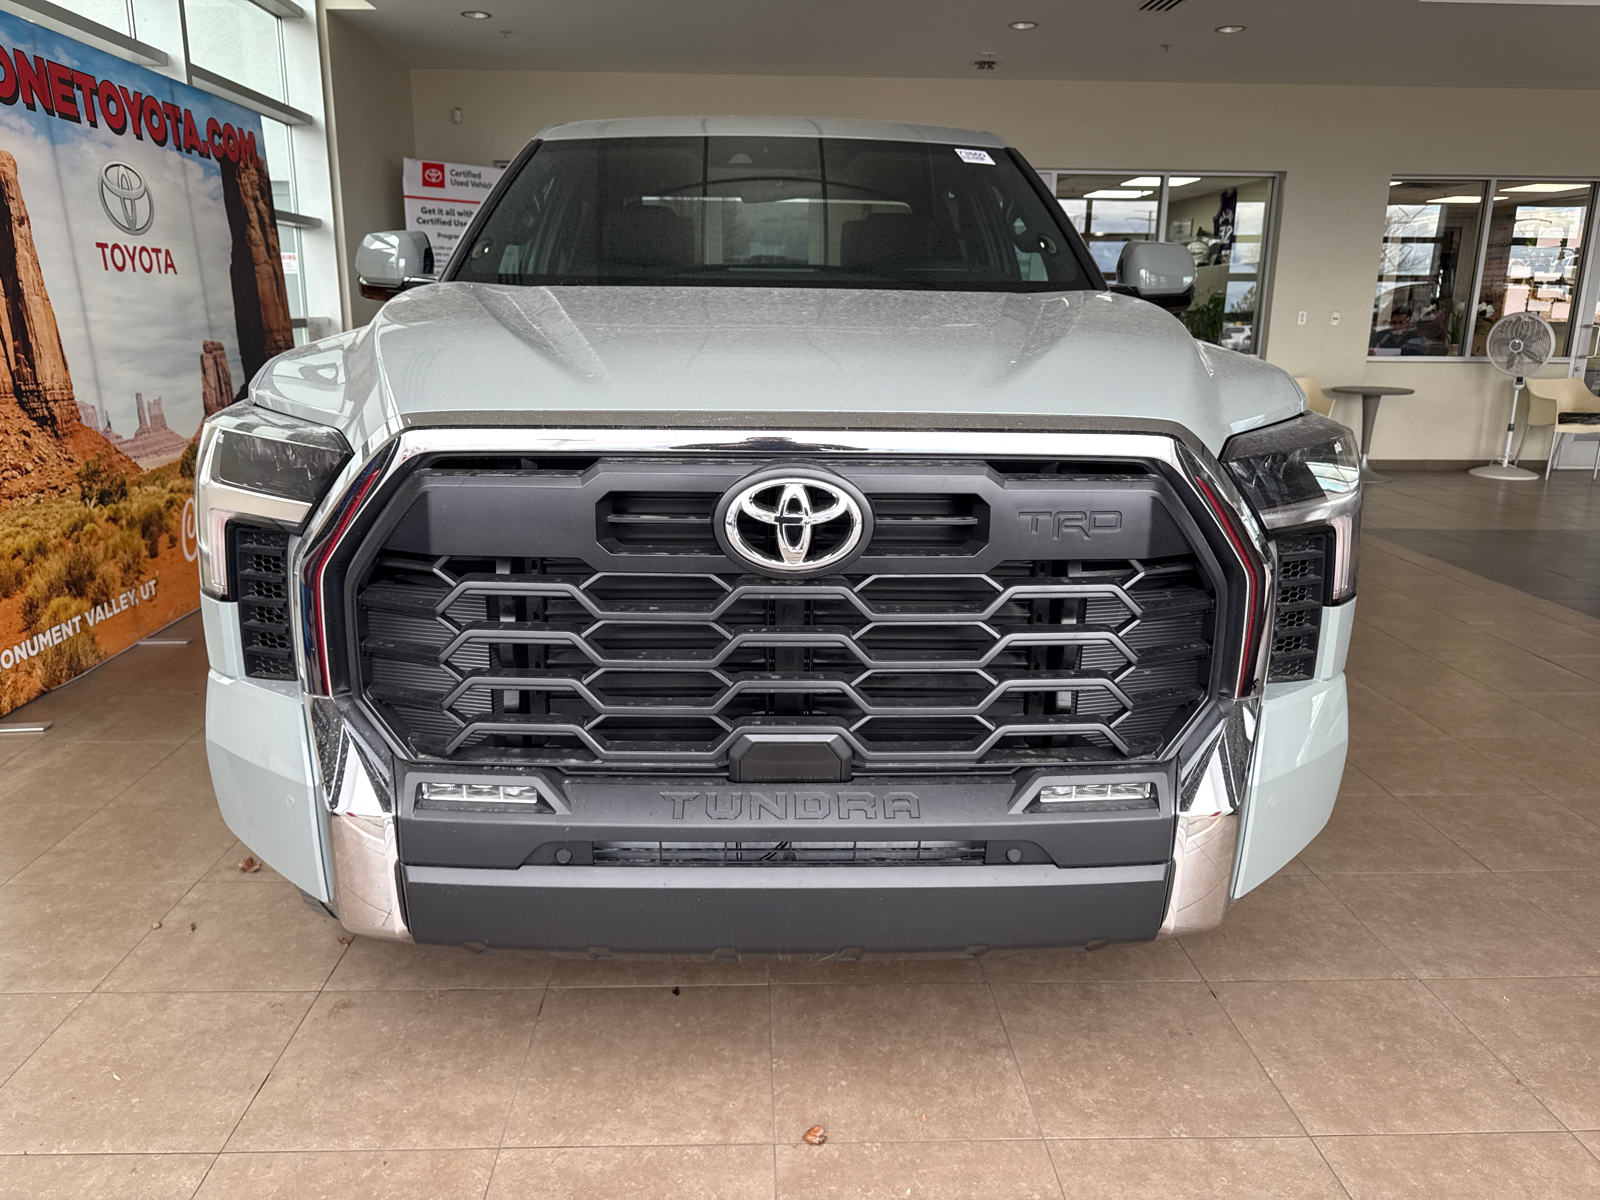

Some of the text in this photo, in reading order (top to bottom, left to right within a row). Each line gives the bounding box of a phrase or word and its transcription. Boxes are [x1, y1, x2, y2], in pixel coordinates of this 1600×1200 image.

[450, 168, 482, 179] Certified
[450, 178, 469, 187] Used
[416, 216, 452, 226] Certified
[421, 206, 435, 215] Get
[437, 207, 443, 215] it
[445, 208, 455, 216] all
[95, 242, 178, 275] TOYOTA
[1018, 510, 1122, 540] TRD
[0, 579, 157, 673] ONUMENT VALLEY, UT
[660, 791, 921, 820] TUNDRA
